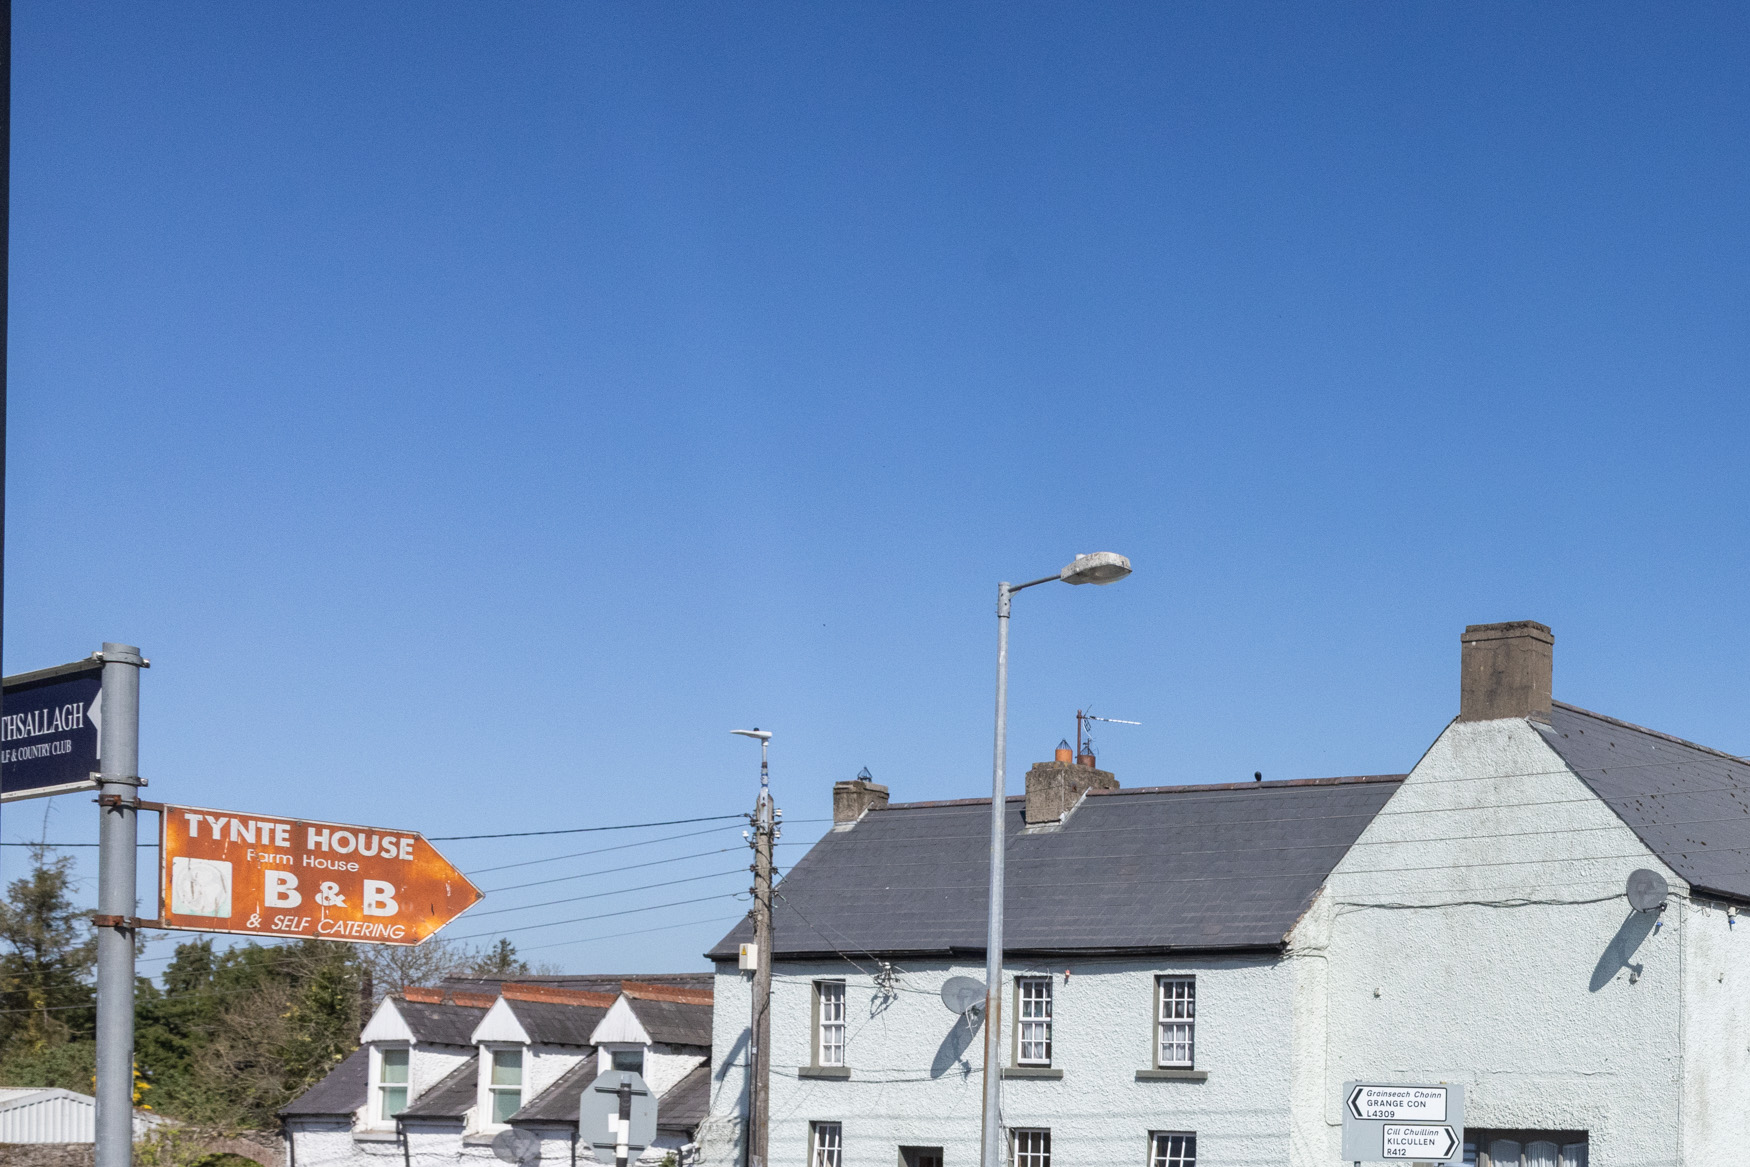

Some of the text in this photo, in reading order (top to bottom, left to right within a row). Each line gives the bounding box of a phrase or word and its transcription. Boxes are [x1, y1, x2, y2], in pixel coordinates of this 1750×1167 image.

[11, 749, 17, 762] &
[18, 743, 51, 761] COUNTRY
[52, 740, 72, 755] CLUB
[184, 813, 415, 861] TYNTE HOUSE
[247, 849, 360, 872] Farm House
[264, 869, 399, 917] B & B
[246, 913, 405, 939] & SELF CATERING
[1366, 1100, 1404, 1108] GRANGE
[1366, 1110, 1395, 1118] L4309
